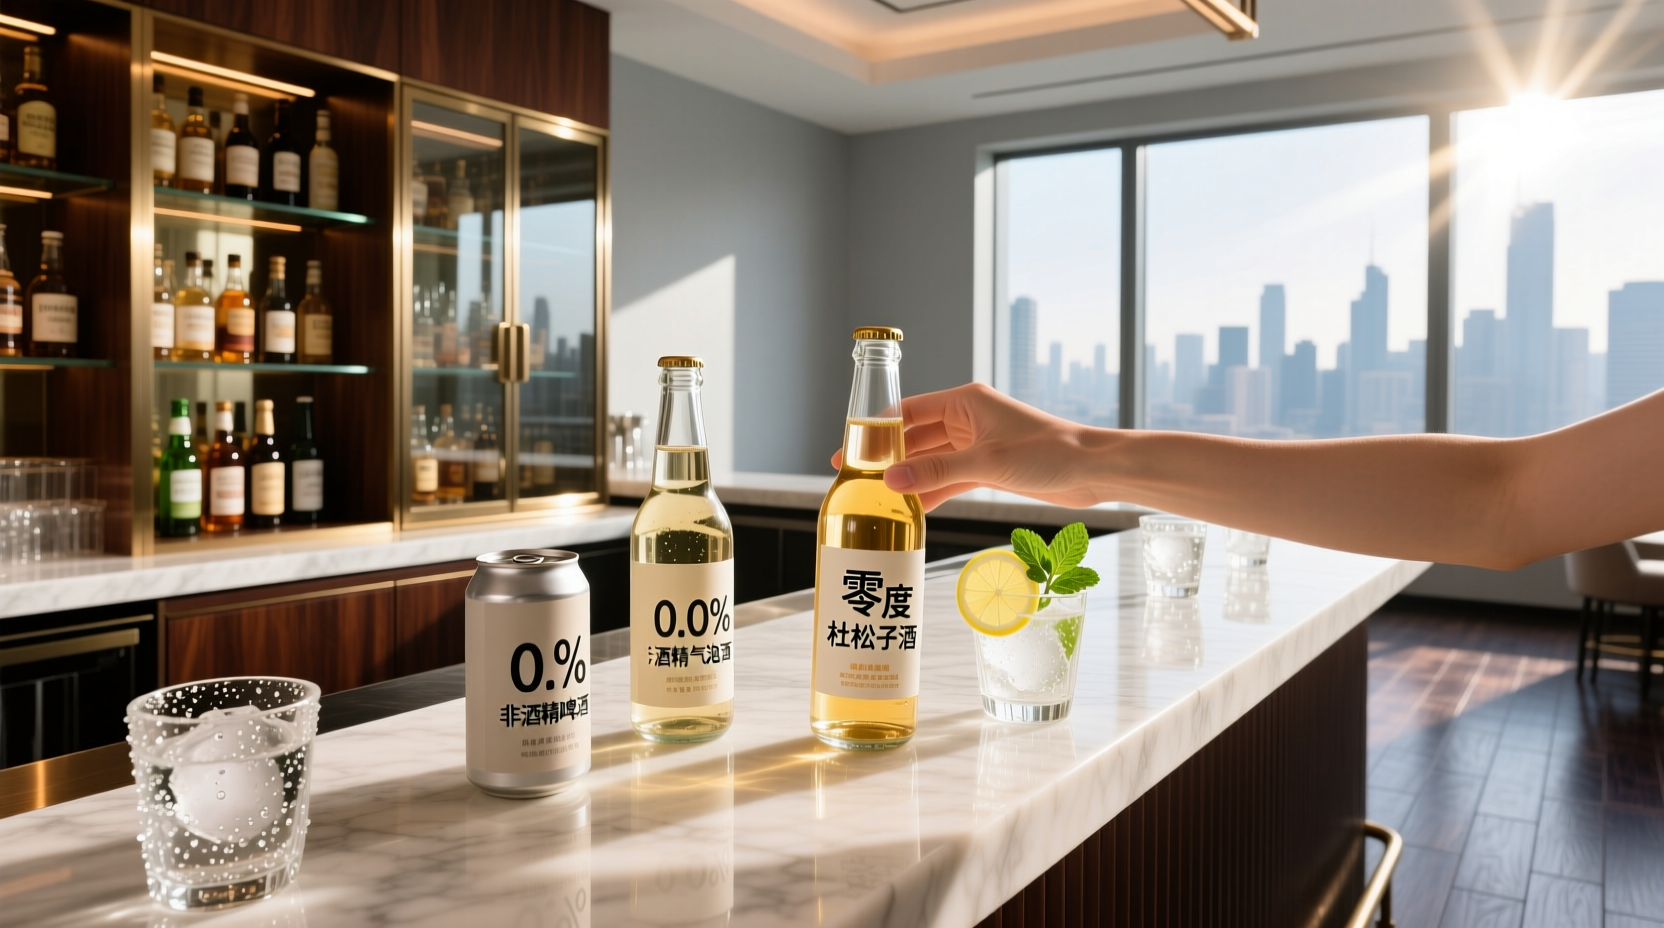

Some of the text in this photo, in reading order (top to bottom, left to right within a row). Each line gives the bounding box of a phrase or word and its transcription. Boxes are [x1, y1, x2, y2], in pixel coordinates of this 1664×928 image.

[841, 569, 914, 619] 零度
[654, 595, 731, 638] 0.0%
[827, 620, 918, 651] 杜松子酒
[510, 635, 587, 693] 0.%
[499, 693, 589, 728] 非酒精啤酒
